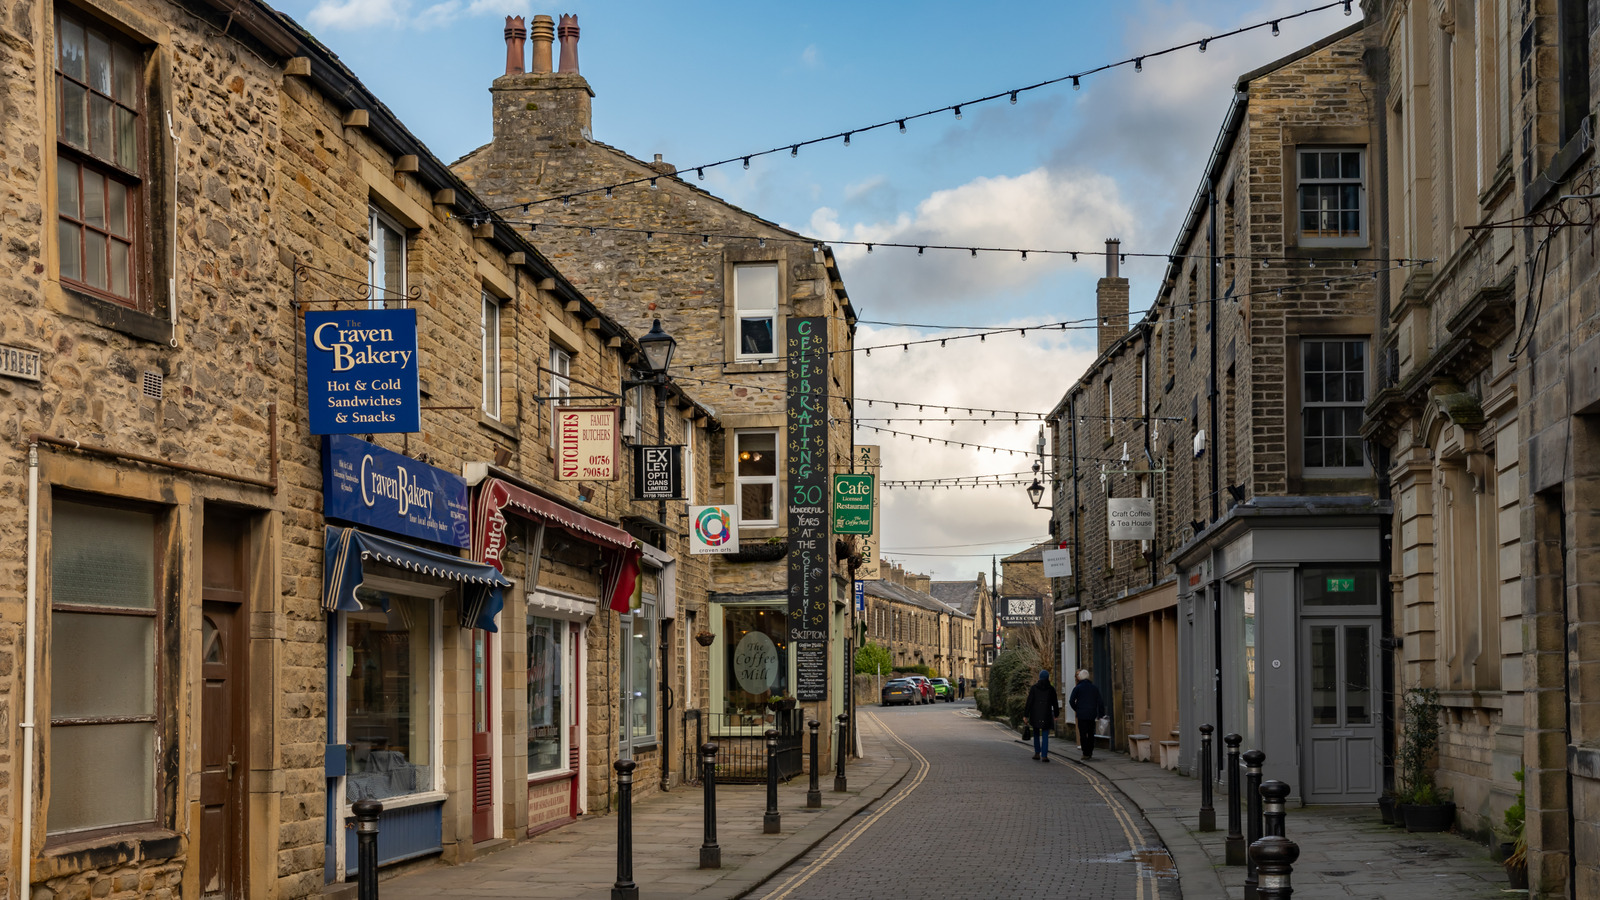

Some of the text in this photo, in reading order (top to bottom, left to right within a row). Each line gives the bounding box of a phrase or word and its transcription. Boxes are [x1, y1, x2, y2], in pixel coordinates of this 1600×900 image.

[314, 322, 394, 351] Craven
[331, 344, 412, 371] Bakery
[328, 378, 401, 392] Hot & Cold
[328, 395, 402, 408] Sandwiches
[798, 320, 814, 479] CELEBRATING
[335, 411, 396, 423] & Snacks
[590, 414, 610, 426] FAMILY
[582, 429, 610, 441] BUTCHERS
[563, 414, 579, 478] SUTCLIFFES
[589, 455, 610, 466] 01756
[647, 450, 668, 462] EX
[583, 468, 610, 478] 790542
[647, 463, 668, 471] LEY
[837, 481, 870, 495] Cafe
[794, 485, 822, 504] 30
[789, 505, 824, 514] WONDERFUL
[797, 514, 820, 526] YEARS
[485, 498, 504, 560] Butch
[801, 528, 815, 538] AT
[797, 540, 816, 549] THE
[802, 551, 810, 596] COFFEE
[747, 642, 764, 651] The
[736, 652, 775, 668] Coffee
[741, 668, 770, 680] Mill
